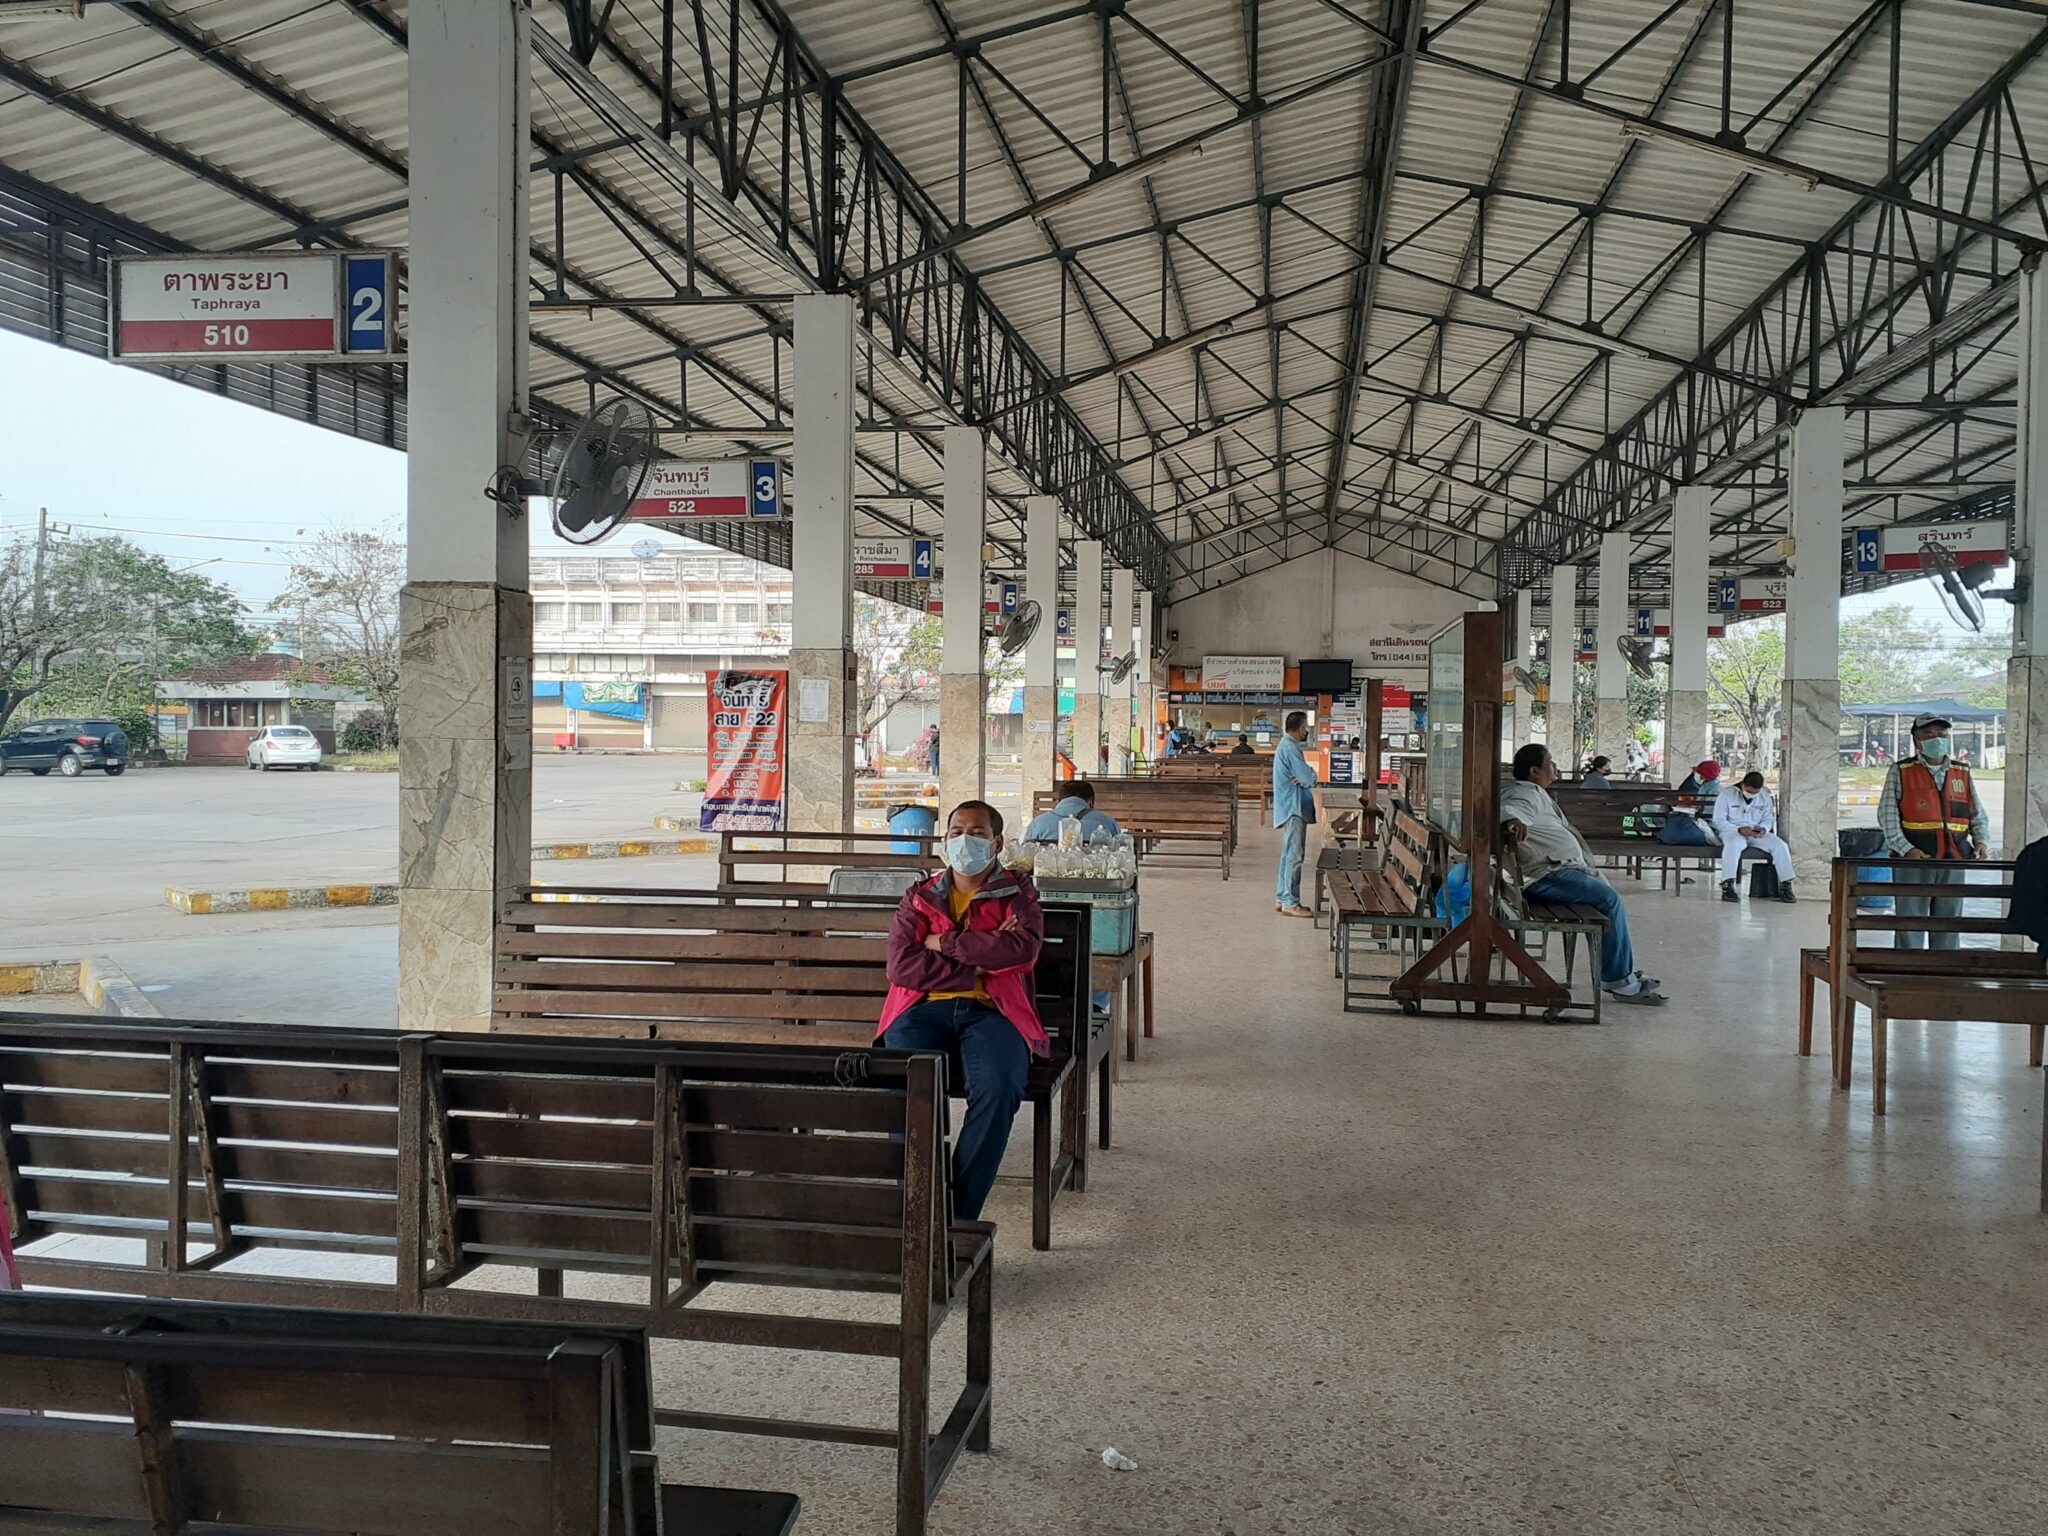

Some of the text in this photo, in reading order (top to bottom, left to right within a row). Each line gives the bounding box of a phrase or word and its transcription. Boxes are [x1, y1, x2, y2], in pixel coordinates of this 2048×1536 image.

[163, 270, 289, 292] ตาพระยา
[191, 298, 261, 311] Taphraya
[352, 287, 383, 332] 2
[204, 325, 249, 345] 510
[653, 466, 710, 488] จันทบุรี
[653, 488, 710, 496] Chanthaburi
[755, 476, 775, 501] 3
[668, 500, 696, 513] 522
[854, 542, 899, 555] ราชสีมา
[1857, 541, 1878, 562] 13
[917, 550, 930, 568] 4
[855, 565, 874, 574] 285
[1005, 591, 1016, 606] 5
[1721, 587, 1736, 603] 12
[1058, 616, 1067, 628] 6
[1638, 617, 1649, 629] 11
[1582, 633, 1593, 645] 10
[1538, 646, 1546, 656] 9
[715, 712, 776, 726] สาย 522
